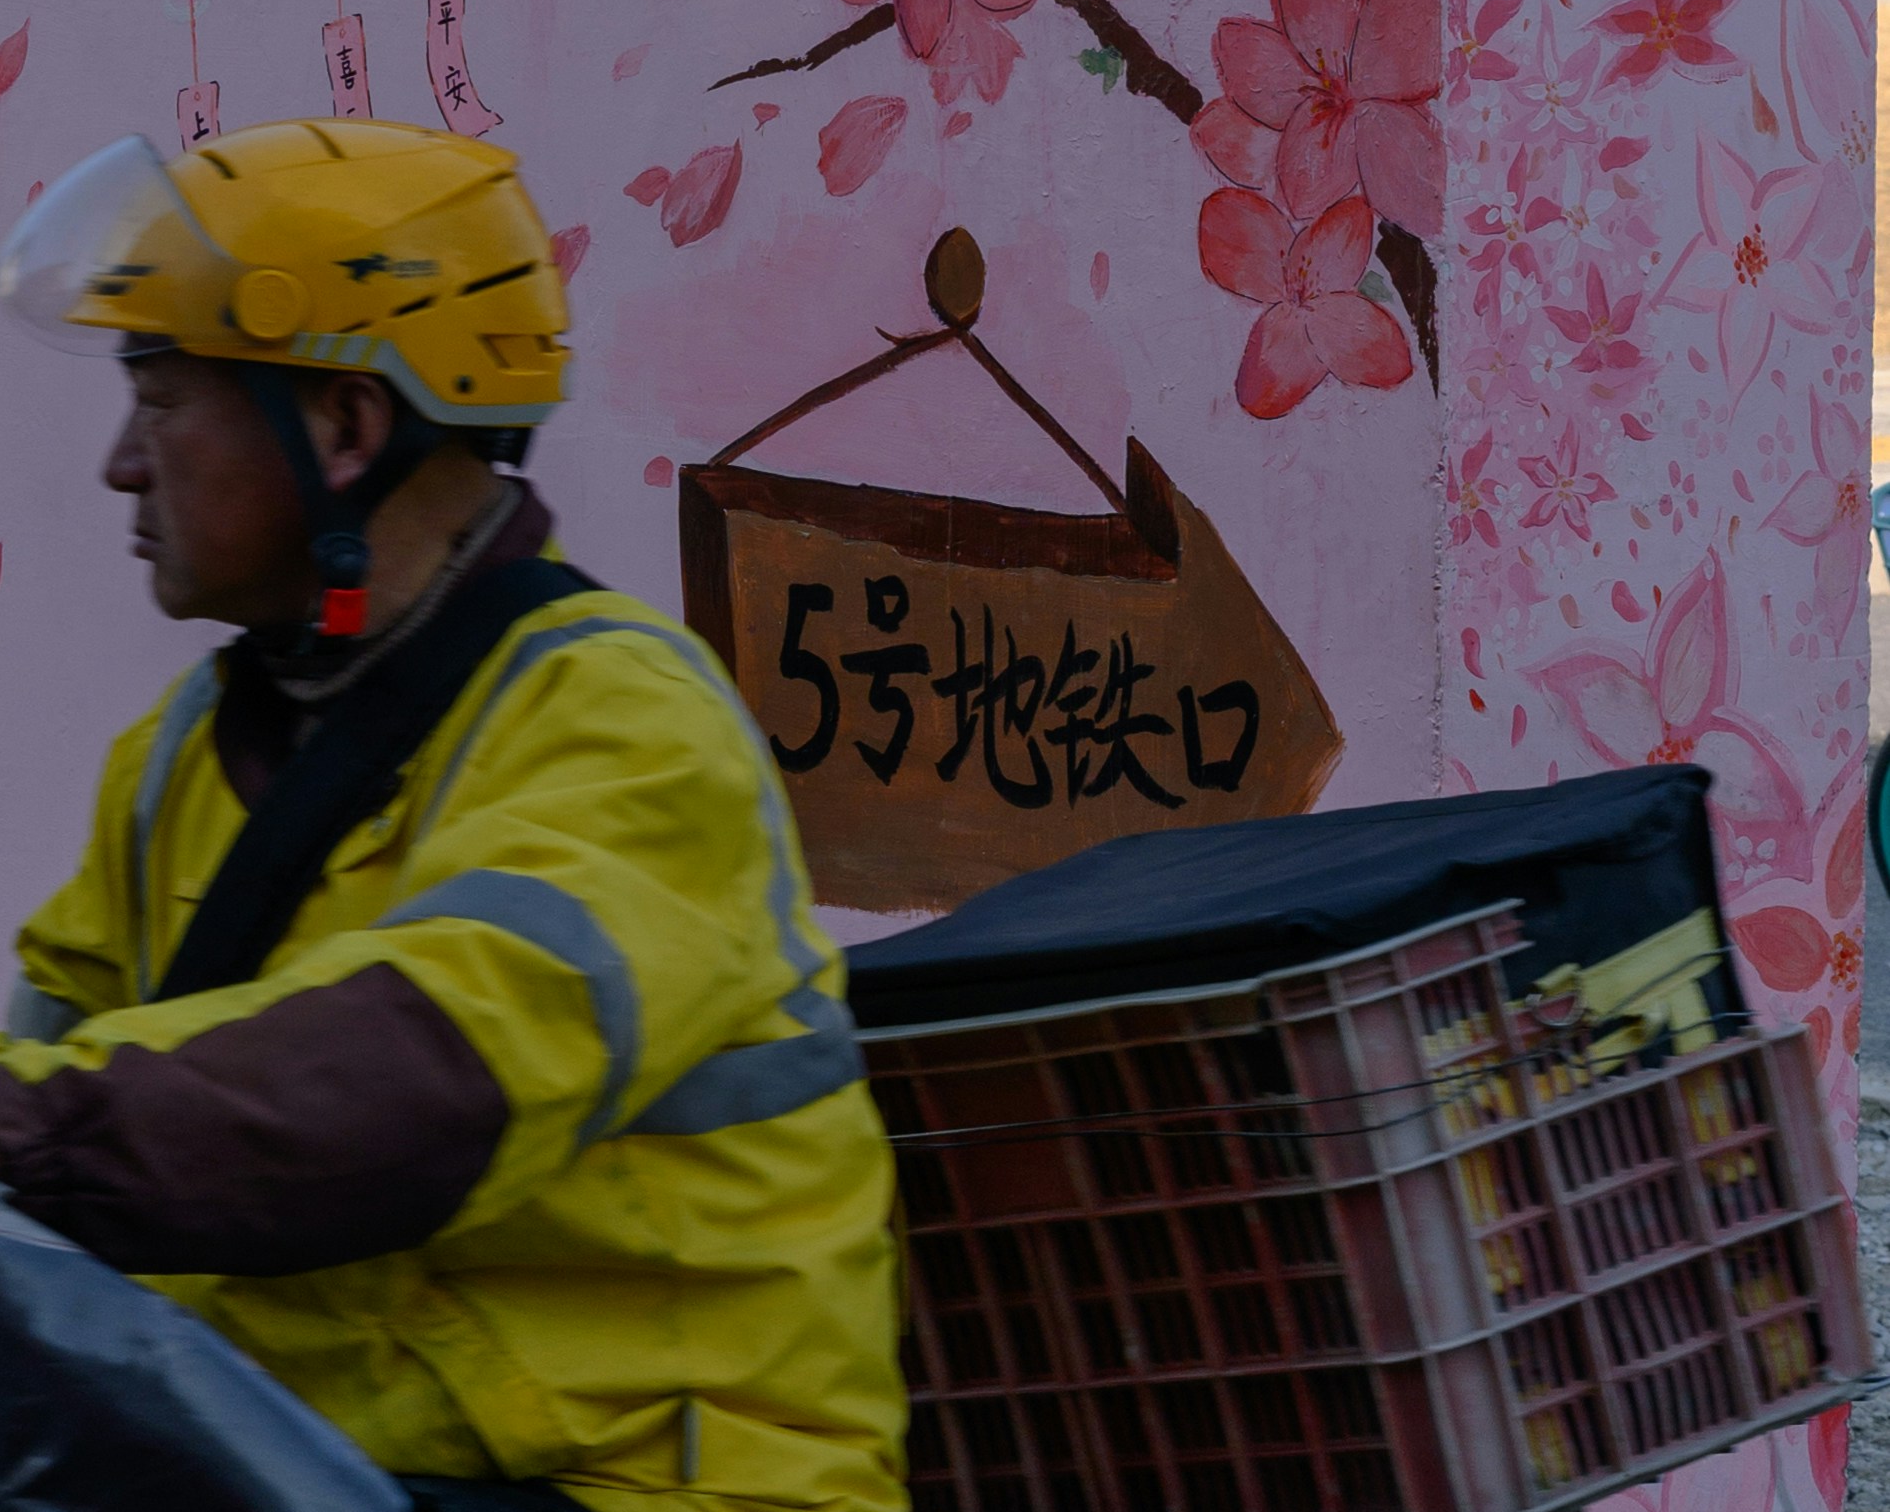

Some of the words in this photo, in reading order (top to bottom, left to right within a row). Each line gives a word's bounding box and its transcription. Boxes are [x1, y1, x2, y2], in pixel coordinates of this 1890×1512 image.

[334, 44, 359, 118] 喜
[436, 0, 468, 112] 平安
[768, 575, 1261, 810] 5号地铁口
